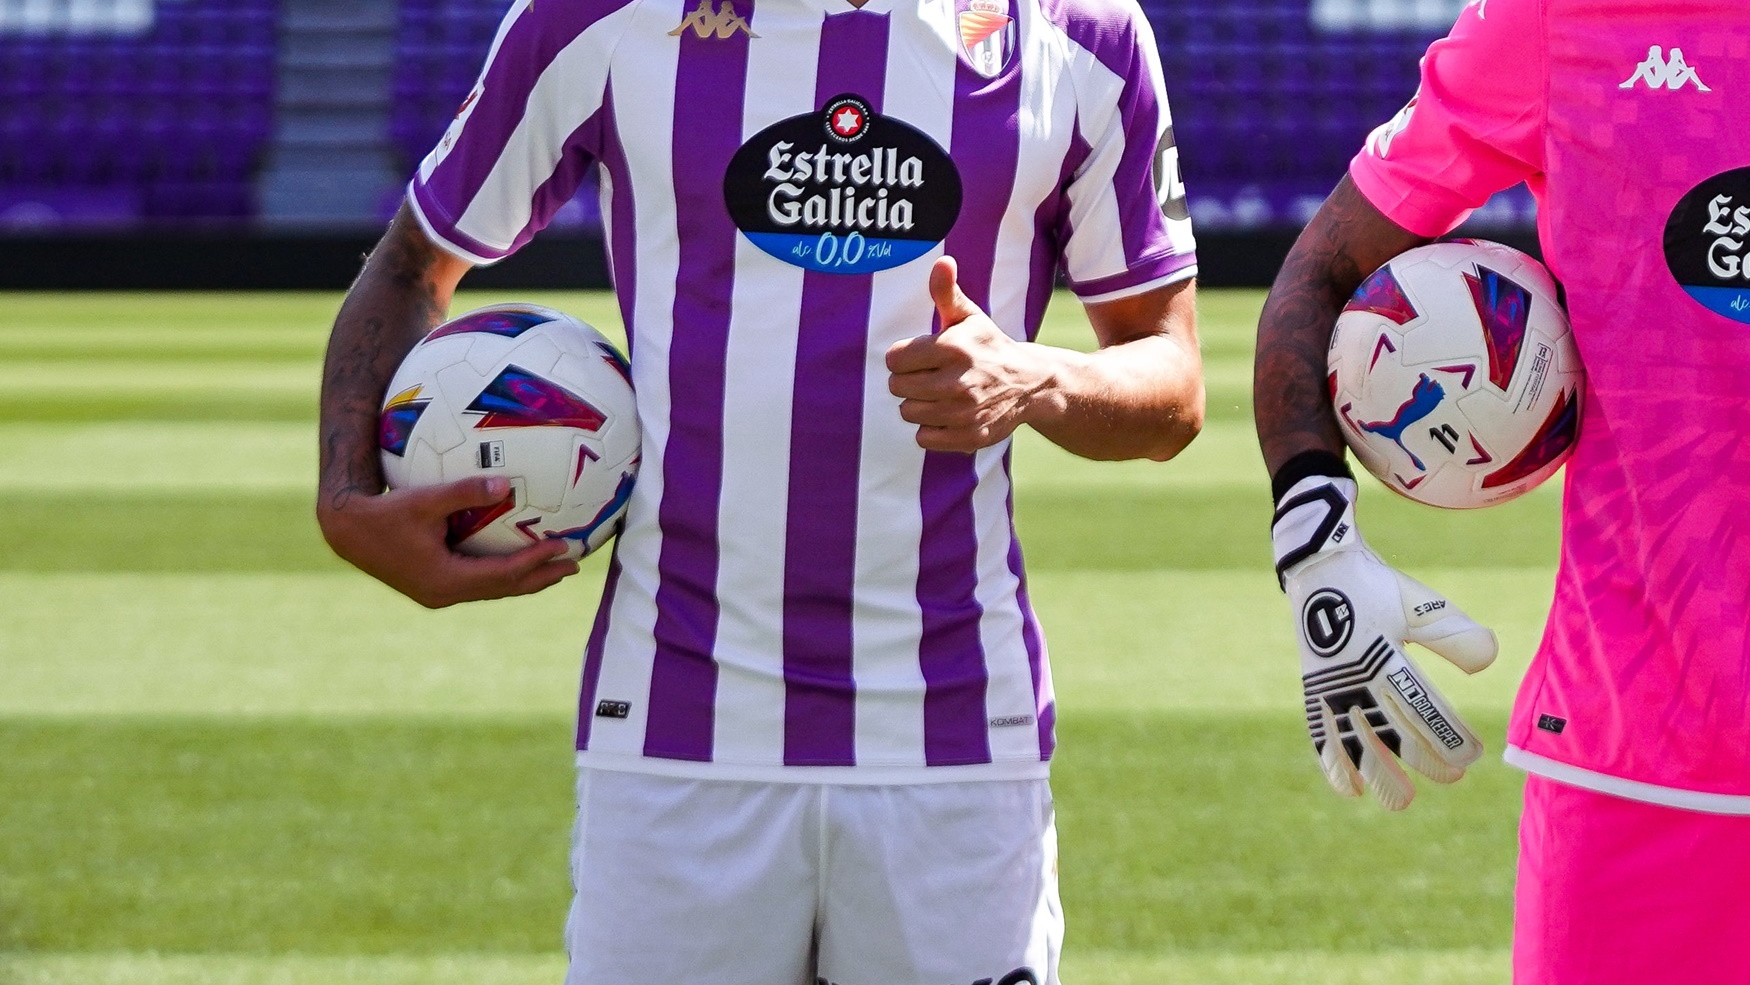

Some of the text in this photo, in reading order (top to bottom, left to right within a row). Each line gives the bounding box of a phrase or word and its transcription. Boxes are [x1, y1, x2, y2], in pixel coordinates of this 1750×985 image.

[763, 140, 924, 187] Estrella
[768, 183, 914, 231] Galicia
[816, 231, 865, 266] 0,0
[1412, 696, 1462, 749] GOALKEEPER
